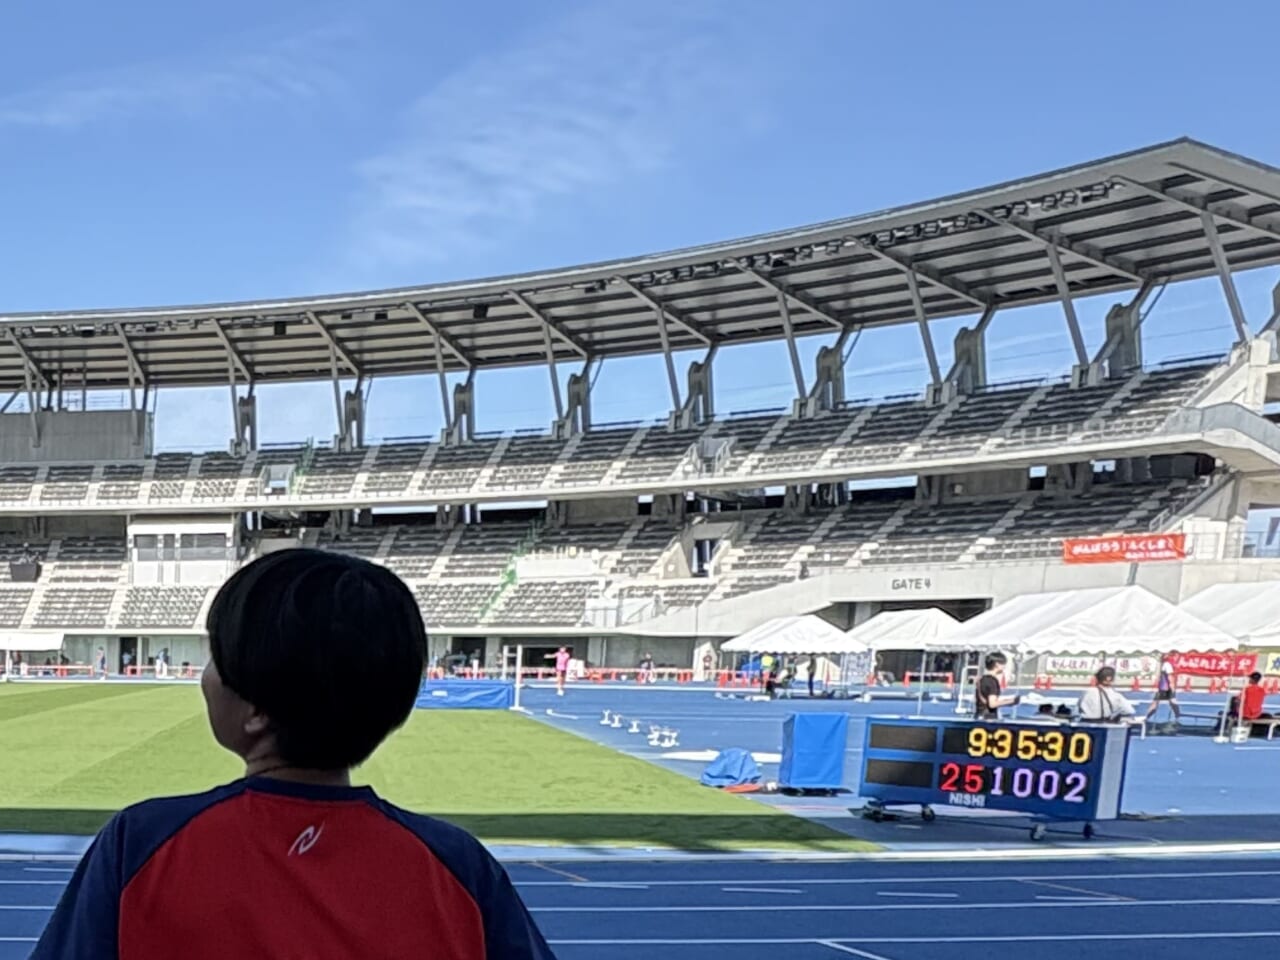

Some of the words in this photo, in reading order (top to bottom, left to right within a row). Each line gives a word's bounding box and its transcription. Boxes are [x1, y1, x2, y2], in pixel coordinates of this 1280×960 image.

[891, 578, 923, 590] GATE
[967, 727, 1091, 763] 9:35:30
[949, 792, 986, 807] NISHI
